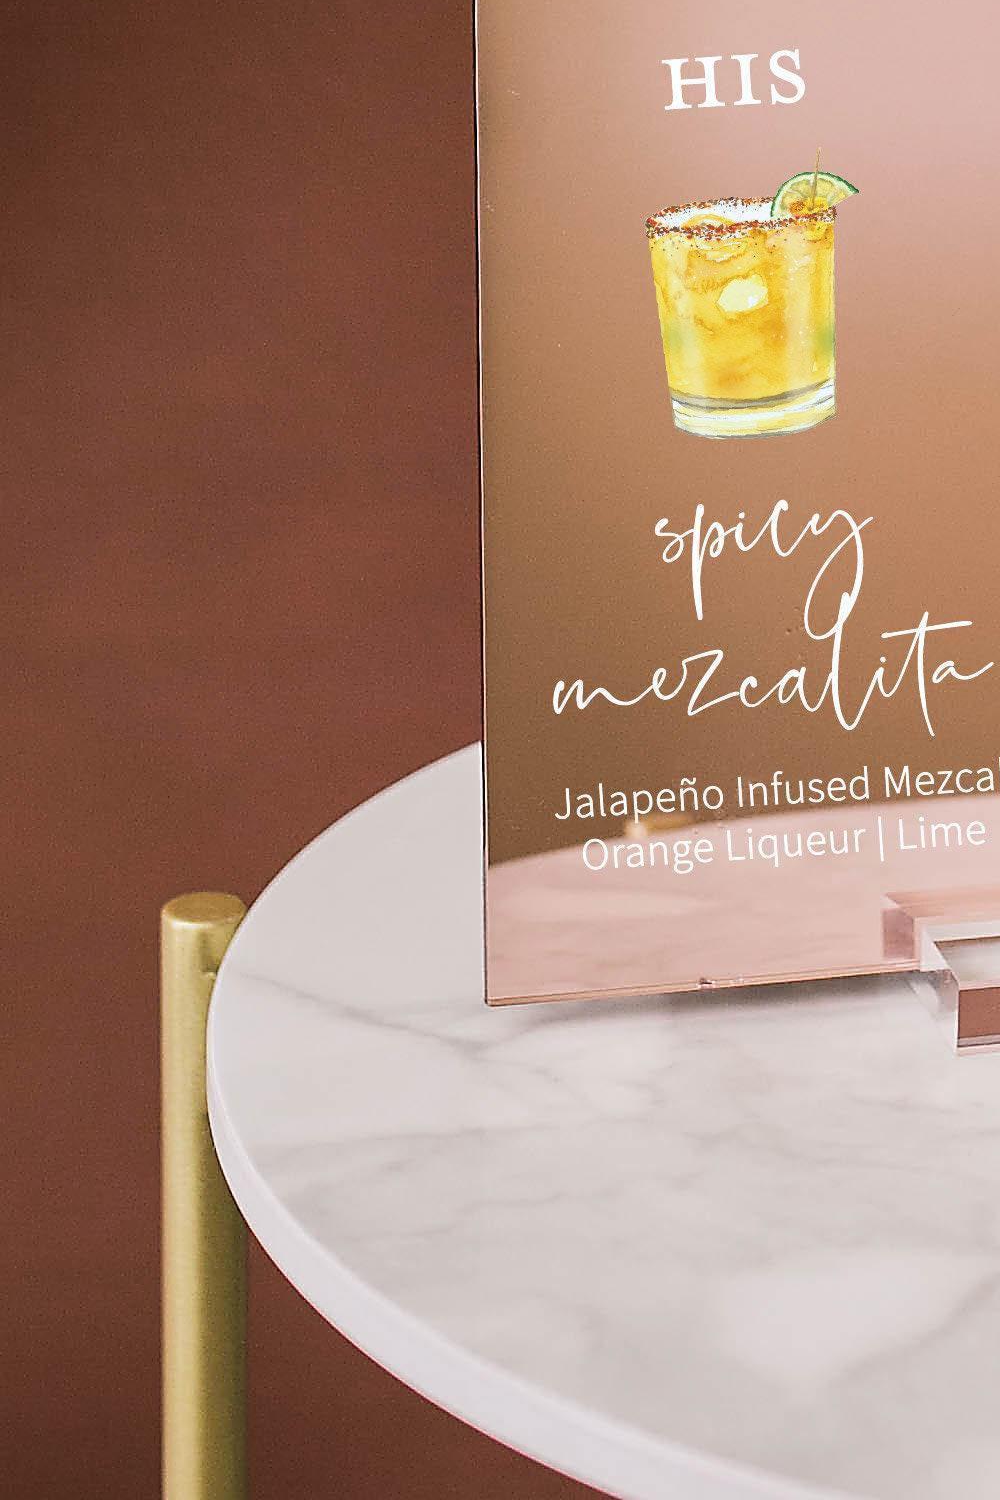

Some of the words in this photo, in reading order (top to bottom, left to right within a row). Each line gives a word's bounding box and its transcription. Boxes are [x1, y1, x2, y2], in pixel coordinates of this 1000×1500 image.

[661, 49, 807, 110] HIS
[654, 499, 873, 639] spicy
[552, 592, 995, 736] mezcalita
[554, 776, 724, 823] Jalapeño
[737, 765, 870, 808] Infused
[582, 838, 714, 874] Orange
[727, 827, 866, 868] Liqueur
[898, 816, 987, 850] Lime
